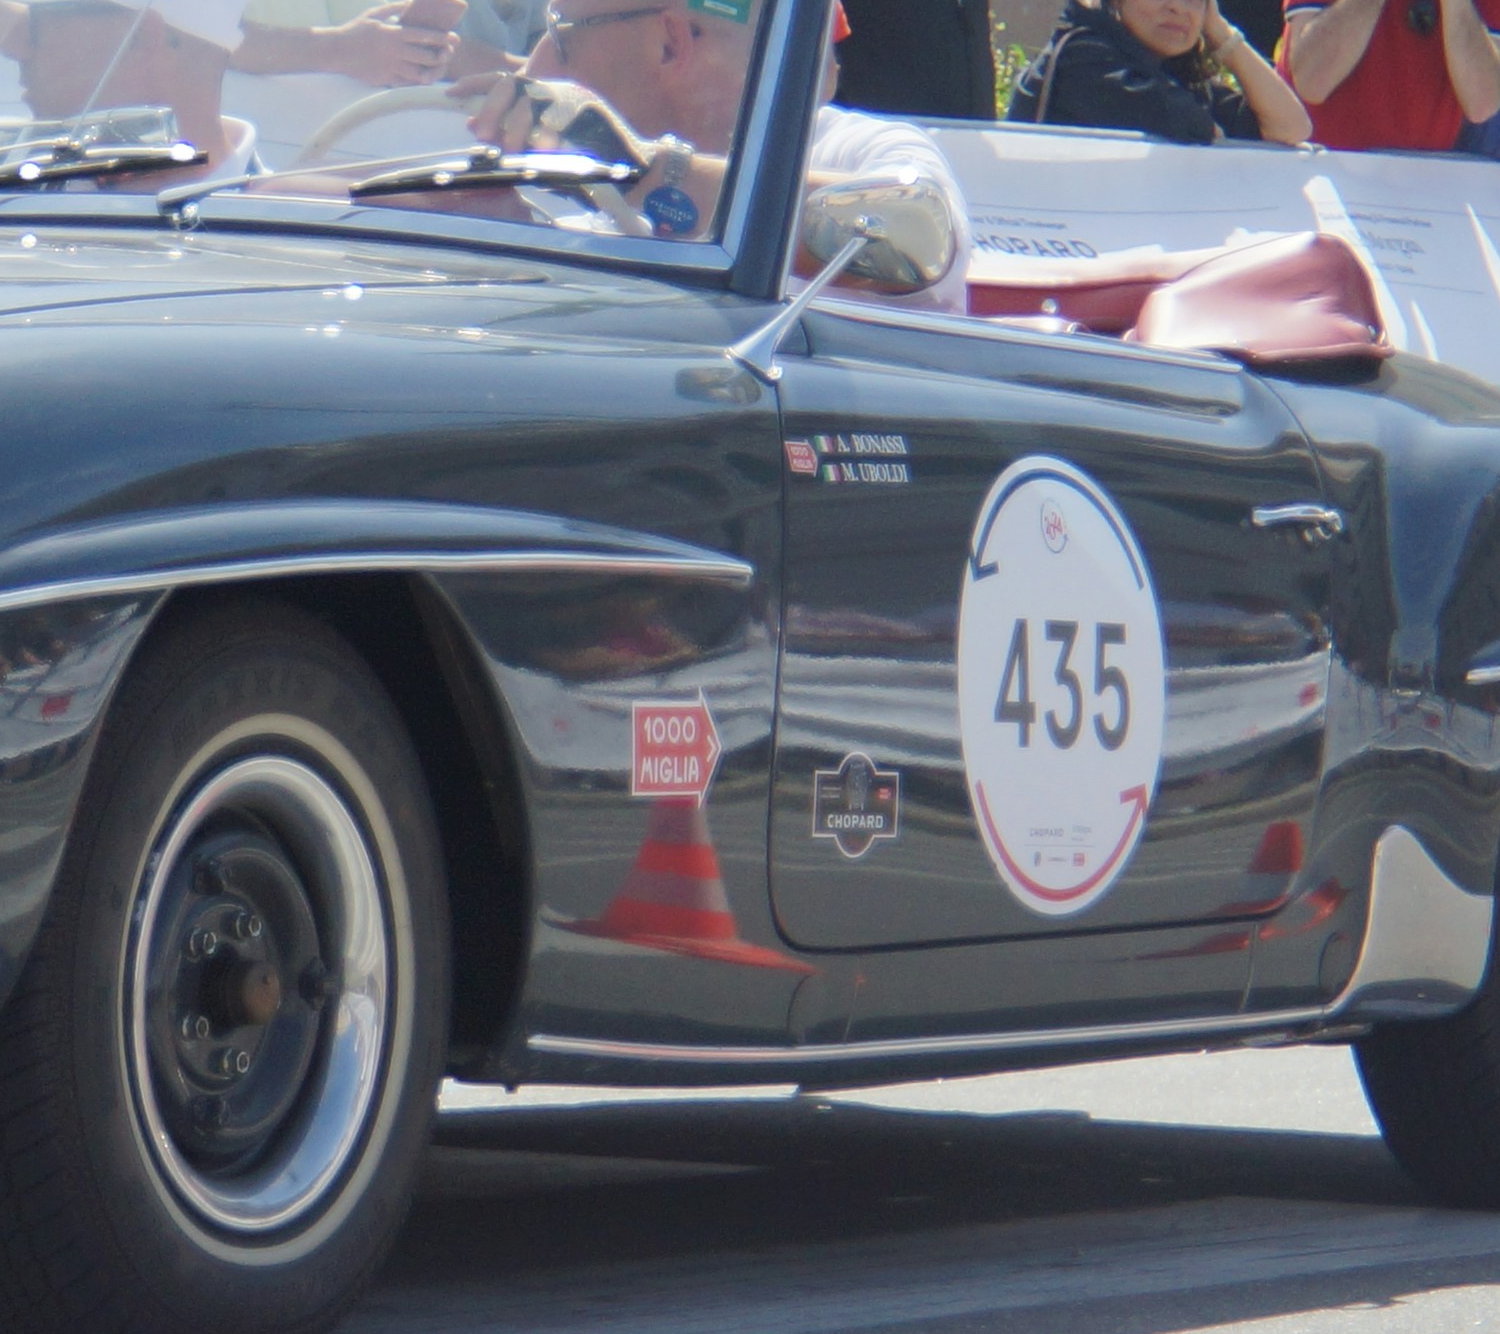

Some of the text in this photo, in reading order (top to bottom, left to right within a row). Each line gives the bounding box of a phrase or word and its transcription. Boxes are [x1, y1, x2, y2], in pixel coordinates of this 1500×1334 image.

[970, 233, 1099, 259] HOPARD
[836, 433, 908, 455] A. BONASSI
[840, 462, 909, 483] M. UBOLDI
[993, 617, 1132, 752] 435
[643, 715, 697, 744] 1000
[639, 755, 700, 785] MIGLIA
[826, 813, 885, 829] CHOPARD
